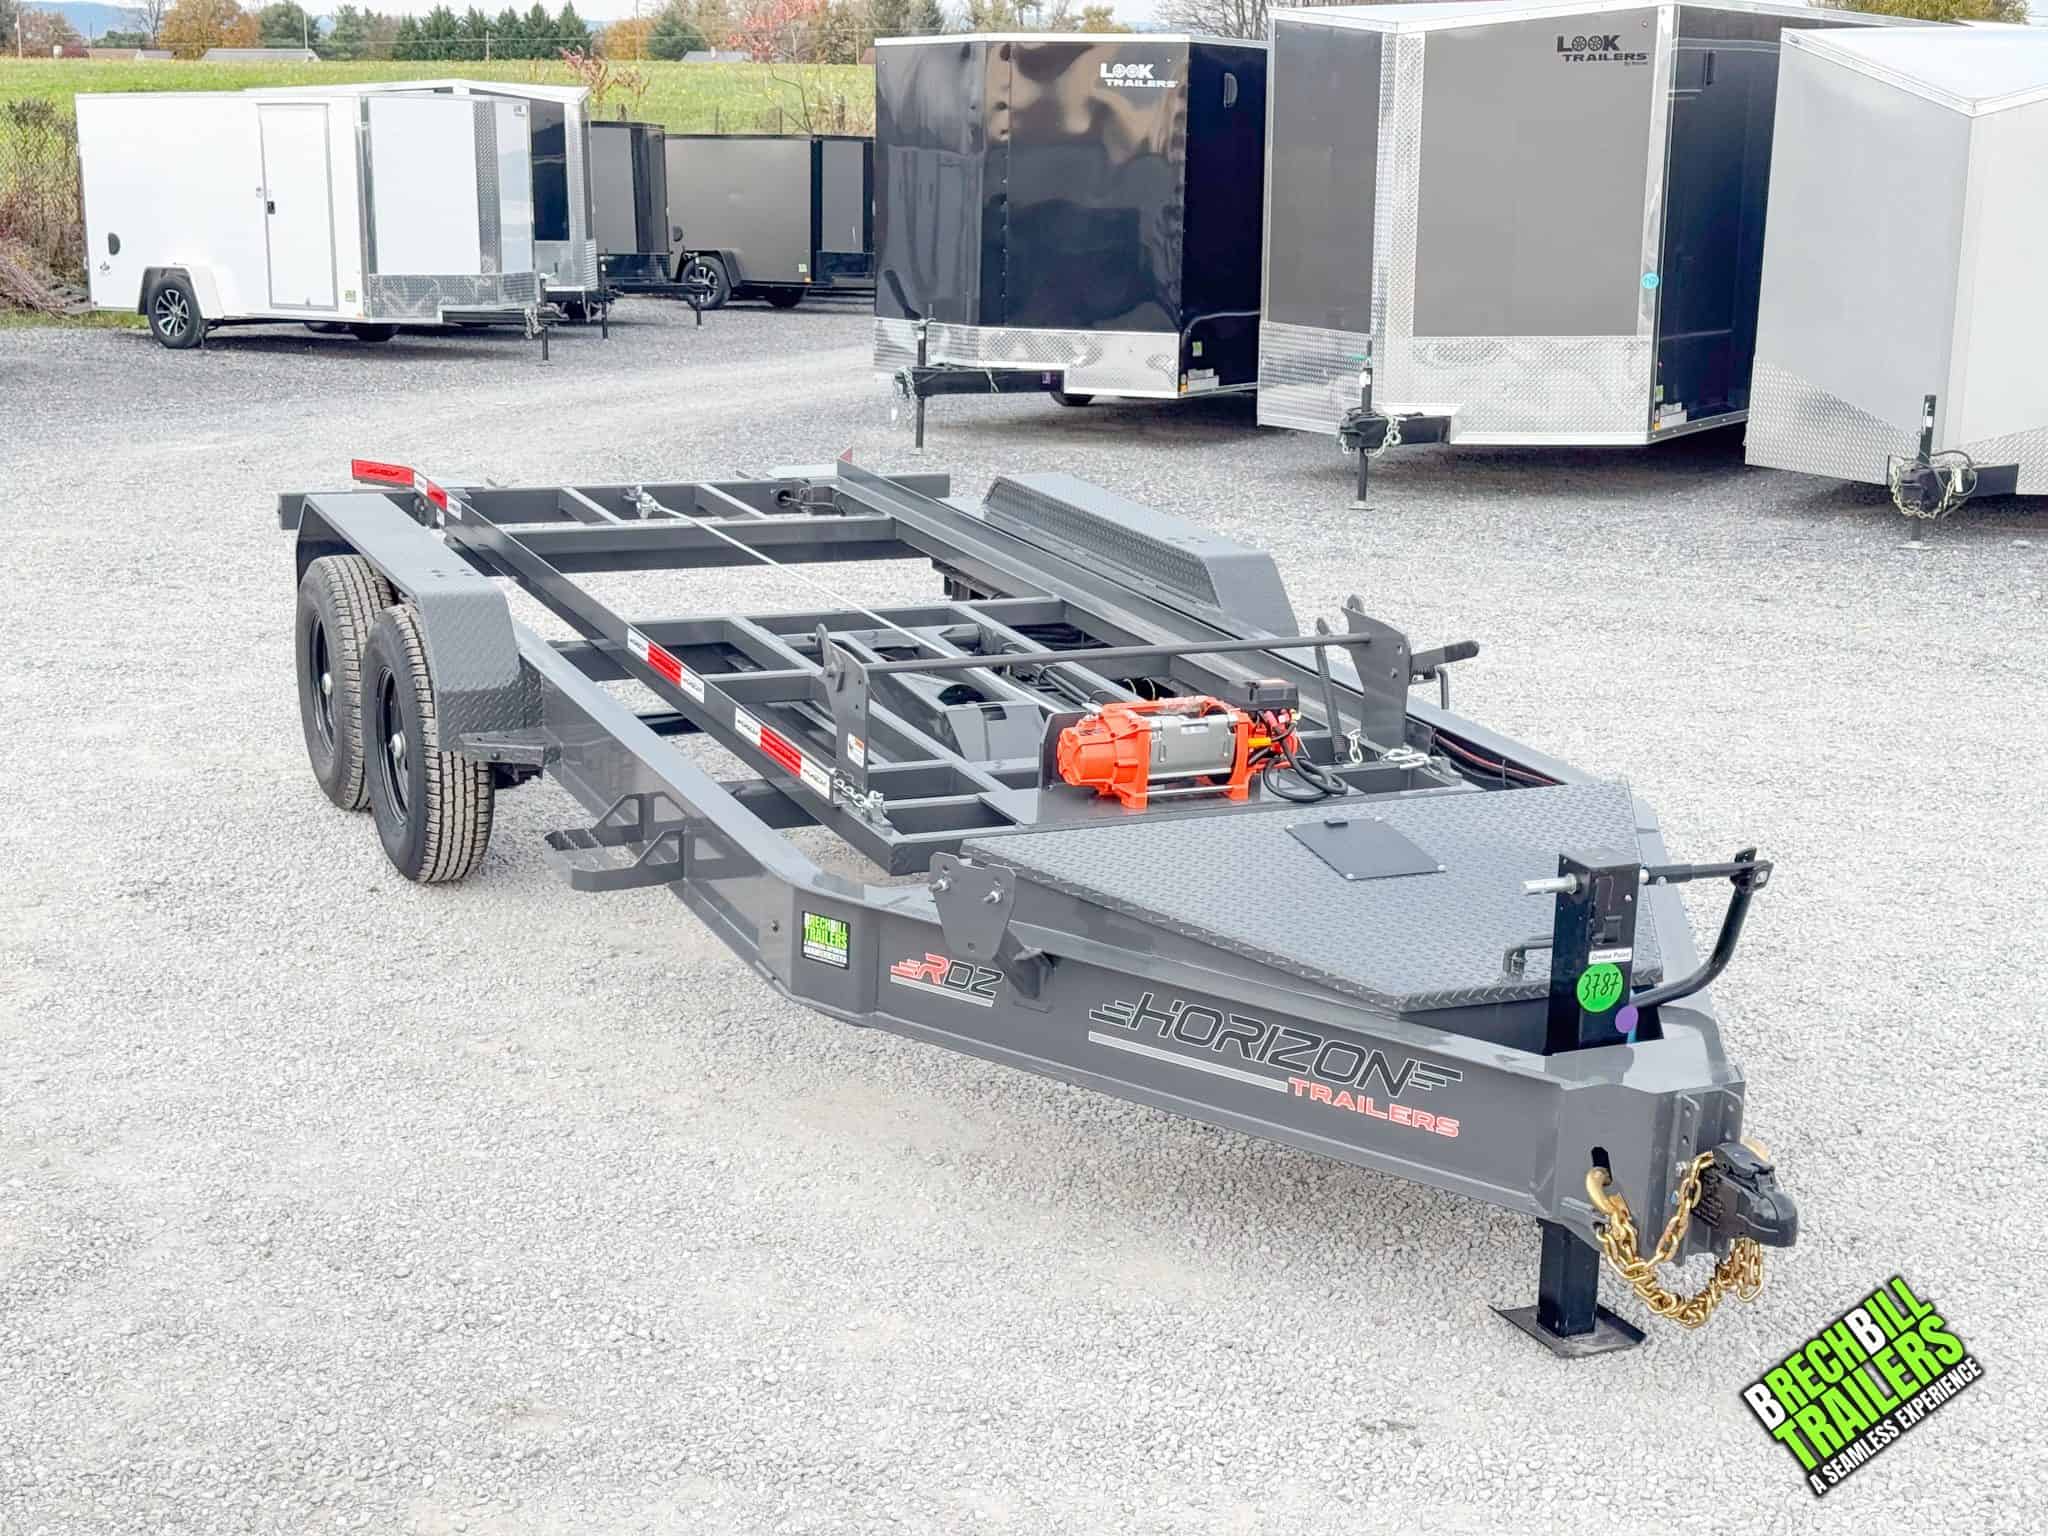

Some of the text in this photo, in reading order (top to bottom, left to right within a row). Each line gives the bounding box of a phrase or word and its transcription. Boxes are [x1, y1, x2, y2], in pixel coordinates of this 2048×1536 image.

[1557, 34, 1621, 52] LOOK
[1562, 53, 1648, 62] TRAILERS
[1100, 64, 1154, 79] LOOK
[1105, 78, 1179, 88] TRAILERS
[804, 927, 848, 950] TRAILERS
[1583, 972, 1619, 1001] 3787
[1129, 992, 1418, 1098] HORIZON
[1288, 1076, 1460, 1138] TRAILERS
